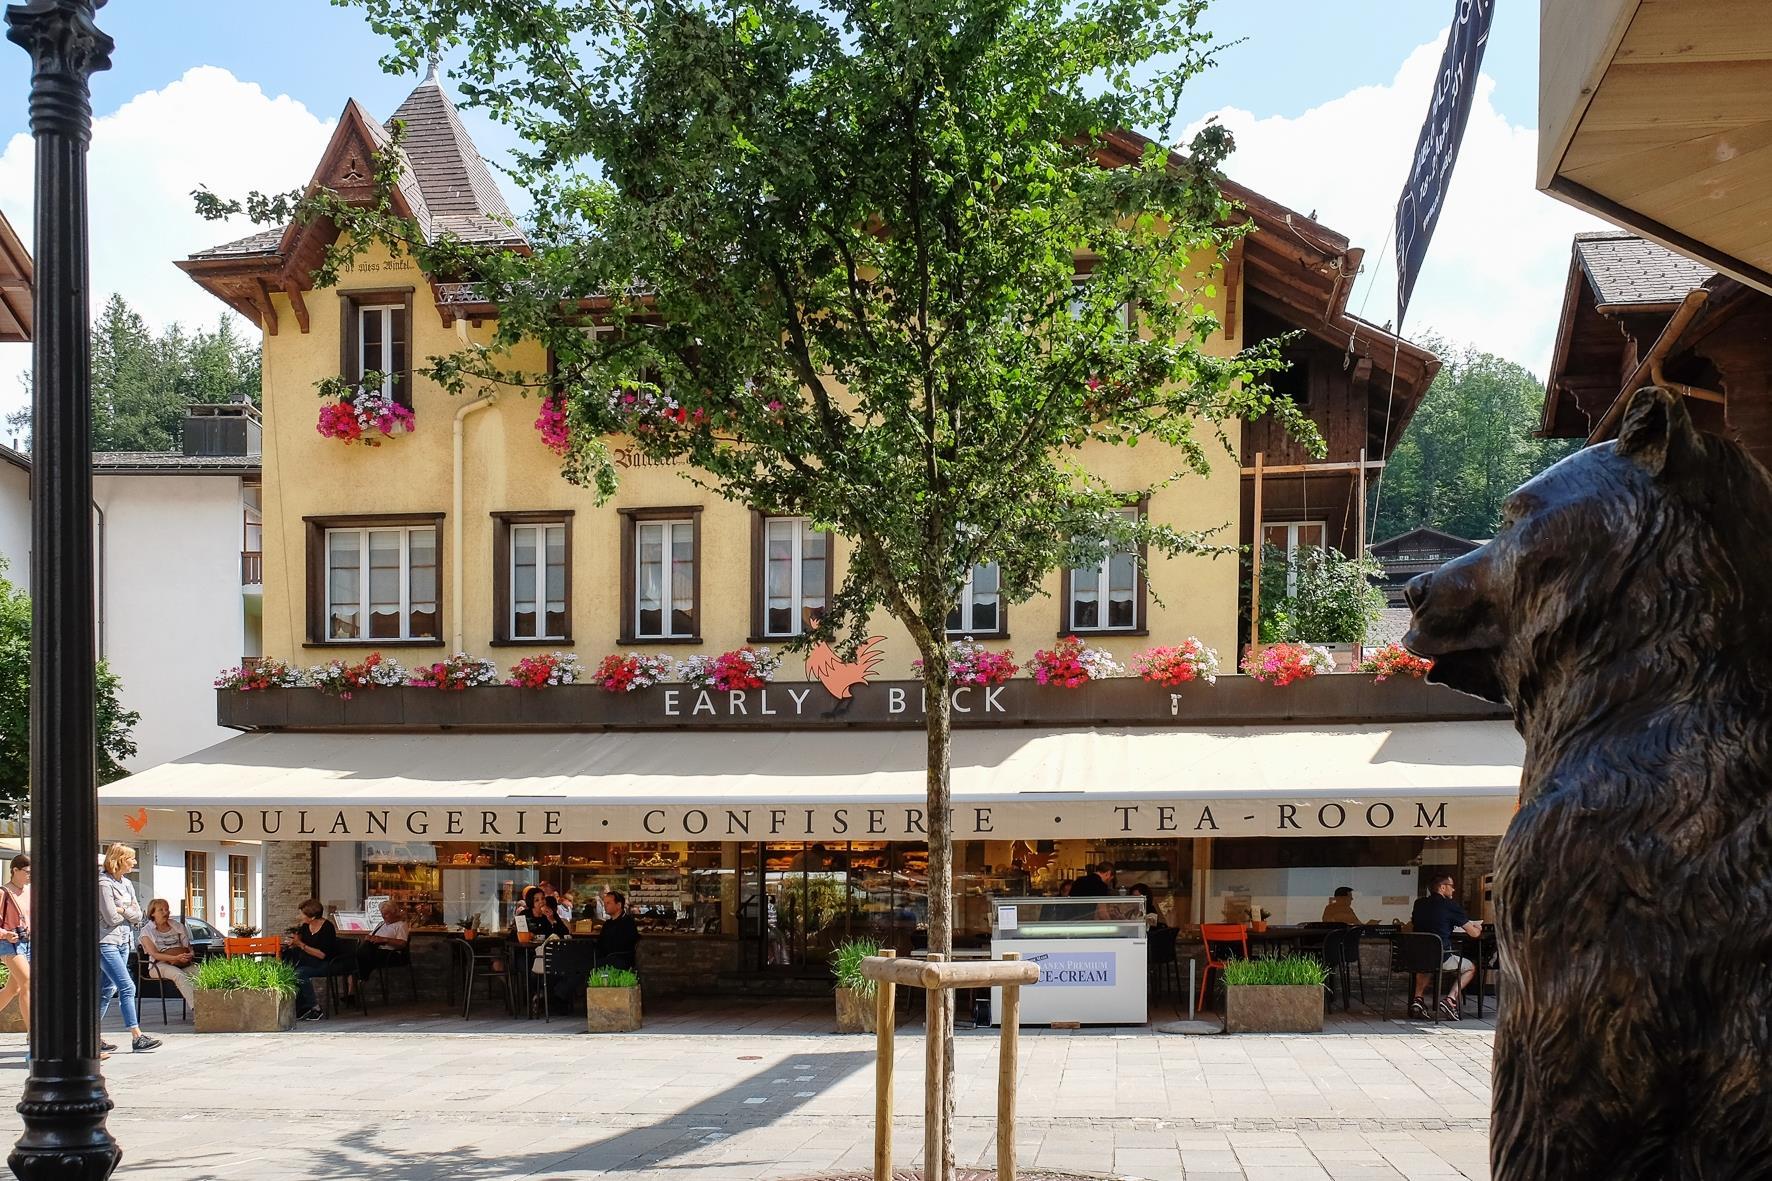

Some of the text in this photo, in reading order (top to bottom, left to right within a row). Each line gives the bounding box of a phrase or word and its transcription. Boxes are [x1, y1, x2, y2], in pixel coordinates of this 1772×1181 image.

[665, 687, 811, 716] EARLY
[187, 810, 563, 836] BOULANGERIE
[1067, 960, 1108, 971] PREMIUM
[1038, 969, 1109, 984] CE-CREAM
